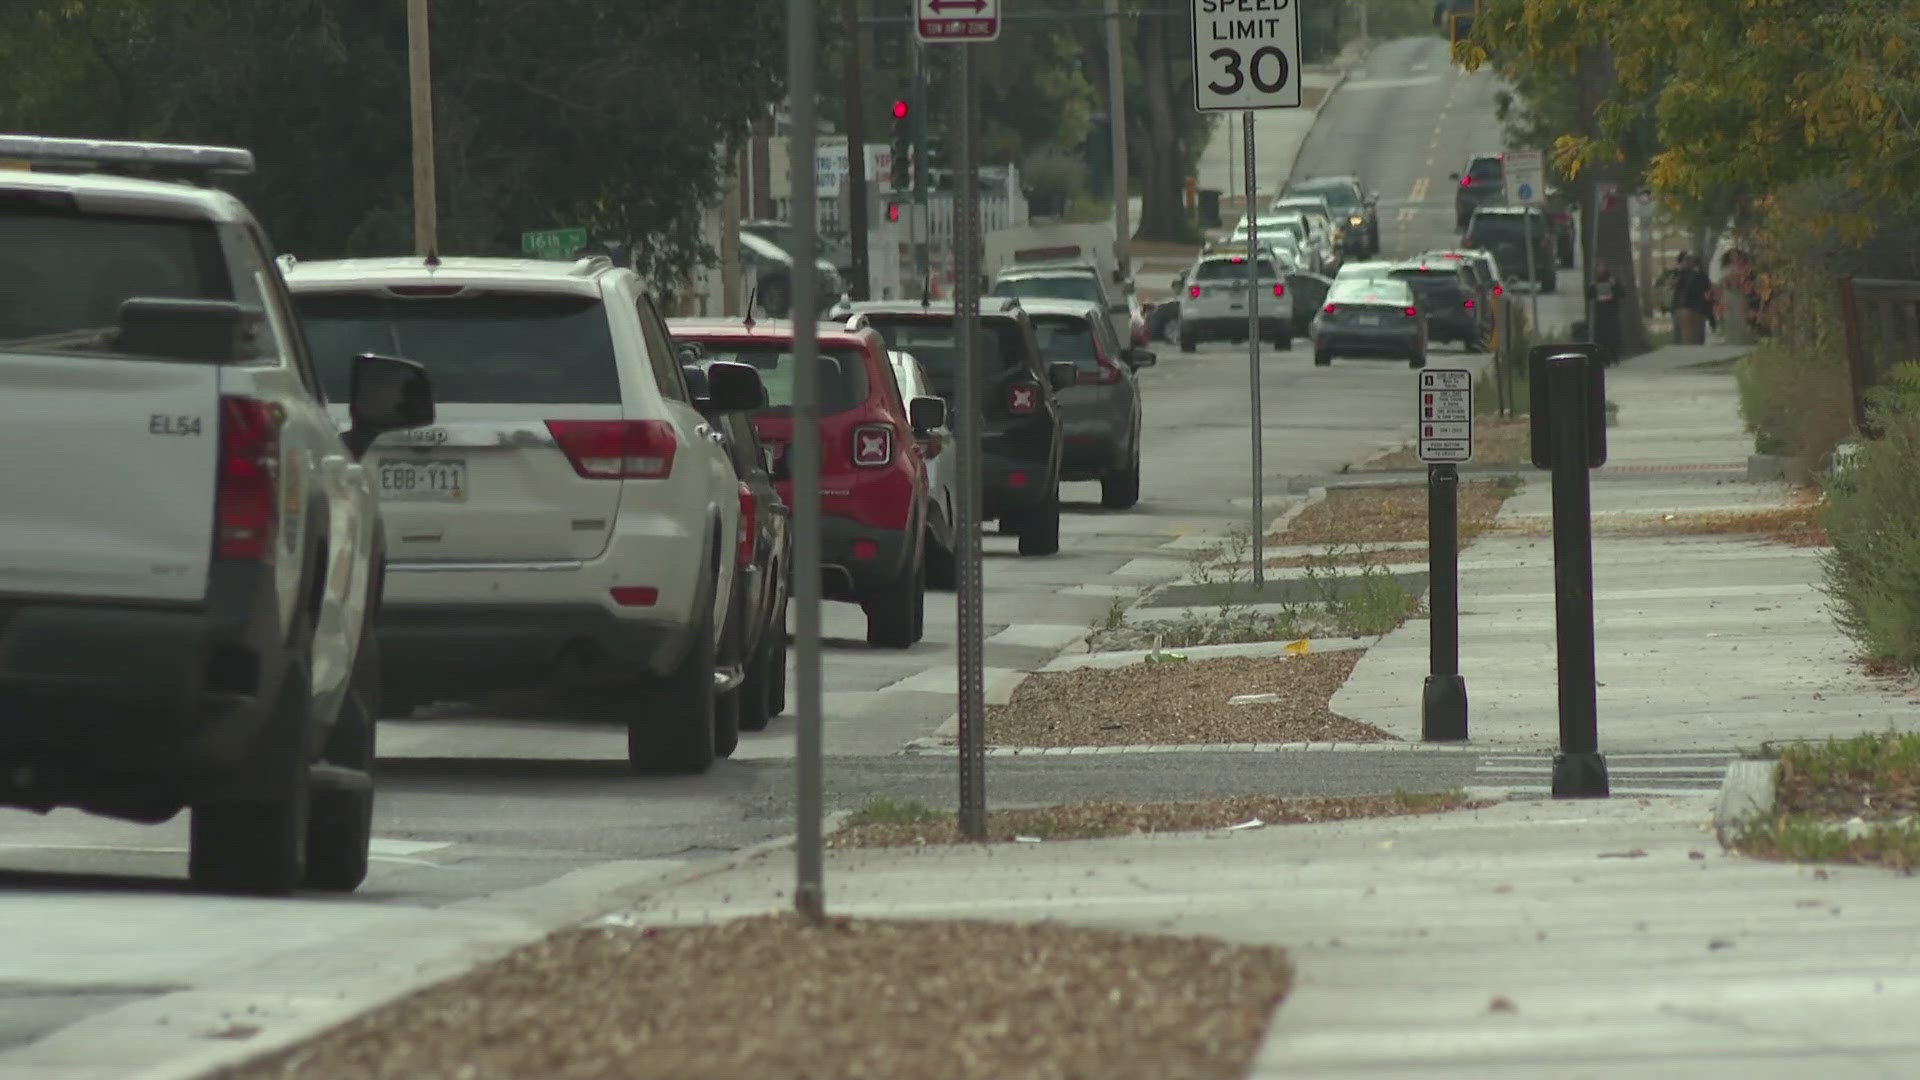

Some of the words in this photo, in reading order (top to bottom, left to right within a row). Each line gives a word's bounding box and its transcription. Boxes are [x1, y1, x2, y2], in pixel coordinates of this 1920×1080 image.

[1203, 0, 1288, 12] SPEED
[1213, 18, 1279, 40] LIMIT
[1208, 46, 1288, 95] 30
